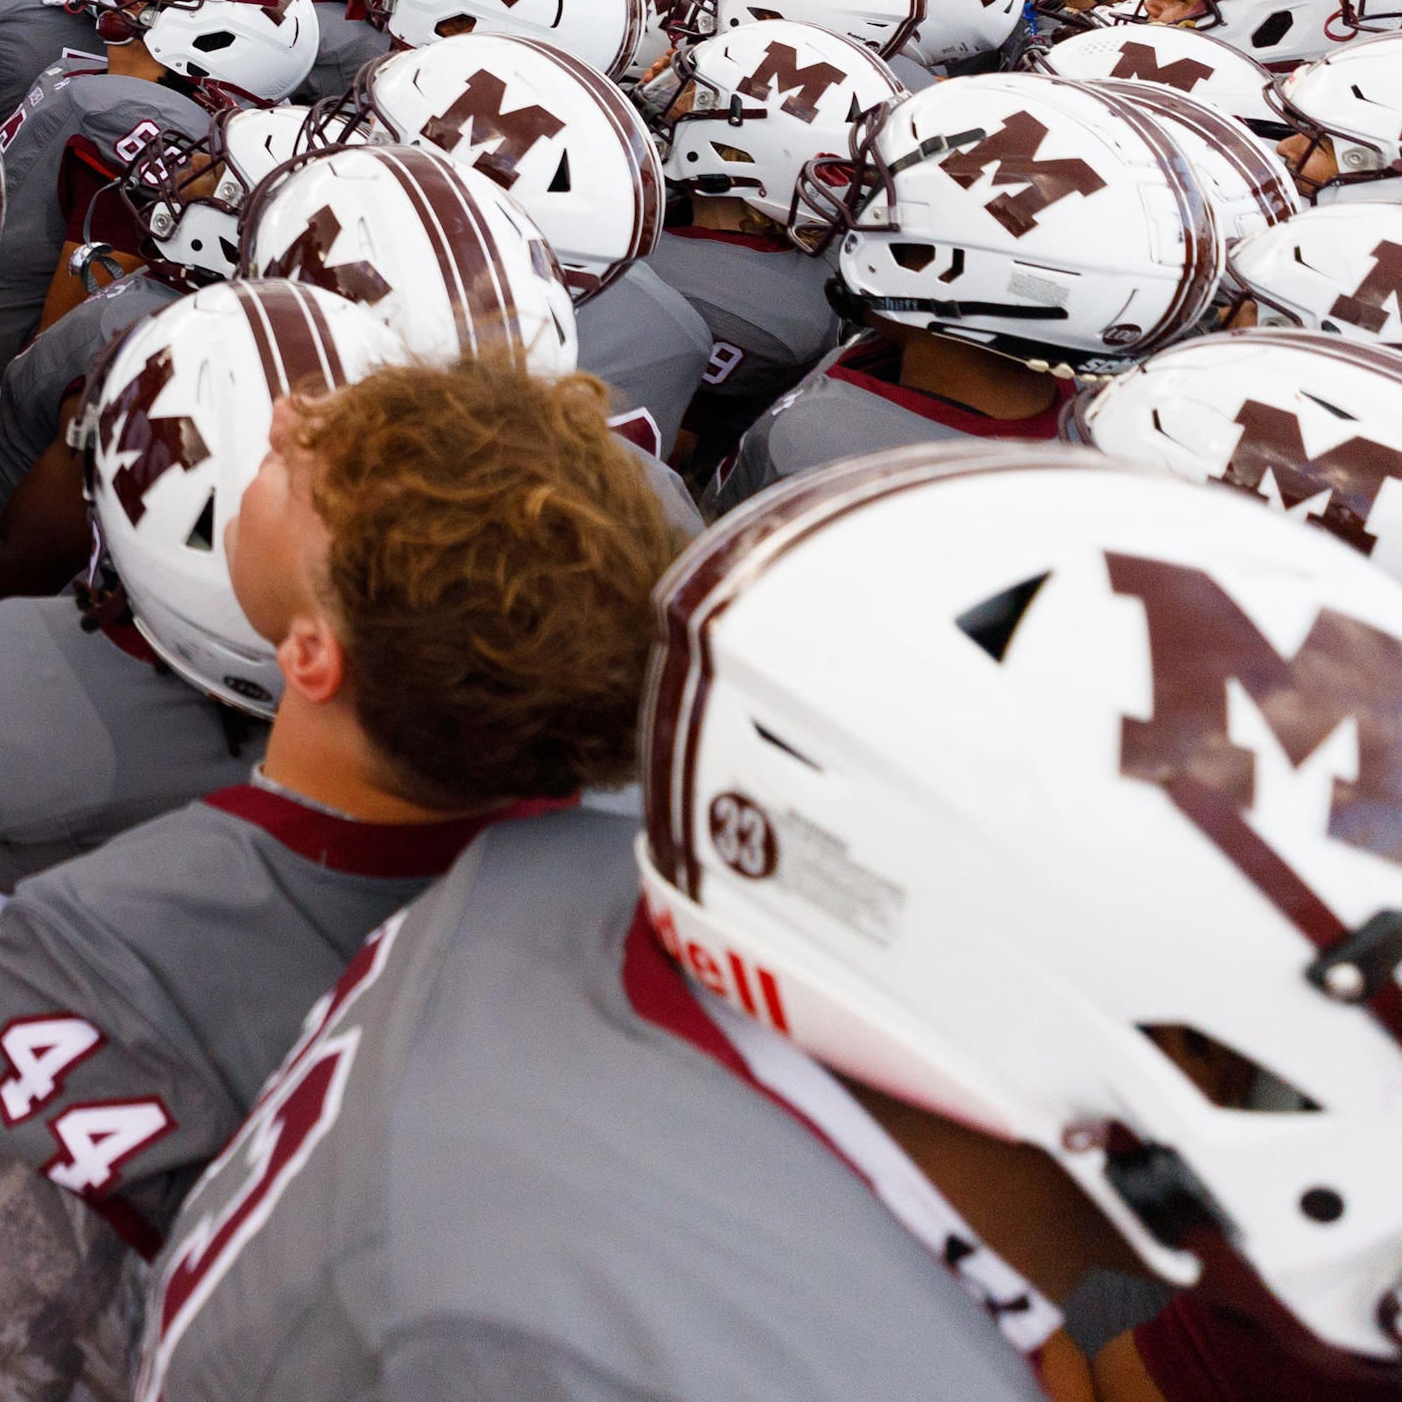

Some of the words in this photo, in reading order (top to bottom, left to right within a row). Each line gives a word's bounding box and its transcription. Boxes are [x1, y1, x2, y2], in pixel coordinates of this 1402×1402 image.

[420, 69, 566, 191] M
[736, 40, 848, 124] M
[939, 110, 1107, 238] M
[1208, 399, 1402, 556] M
[1103, 550, 1402, 864] M
